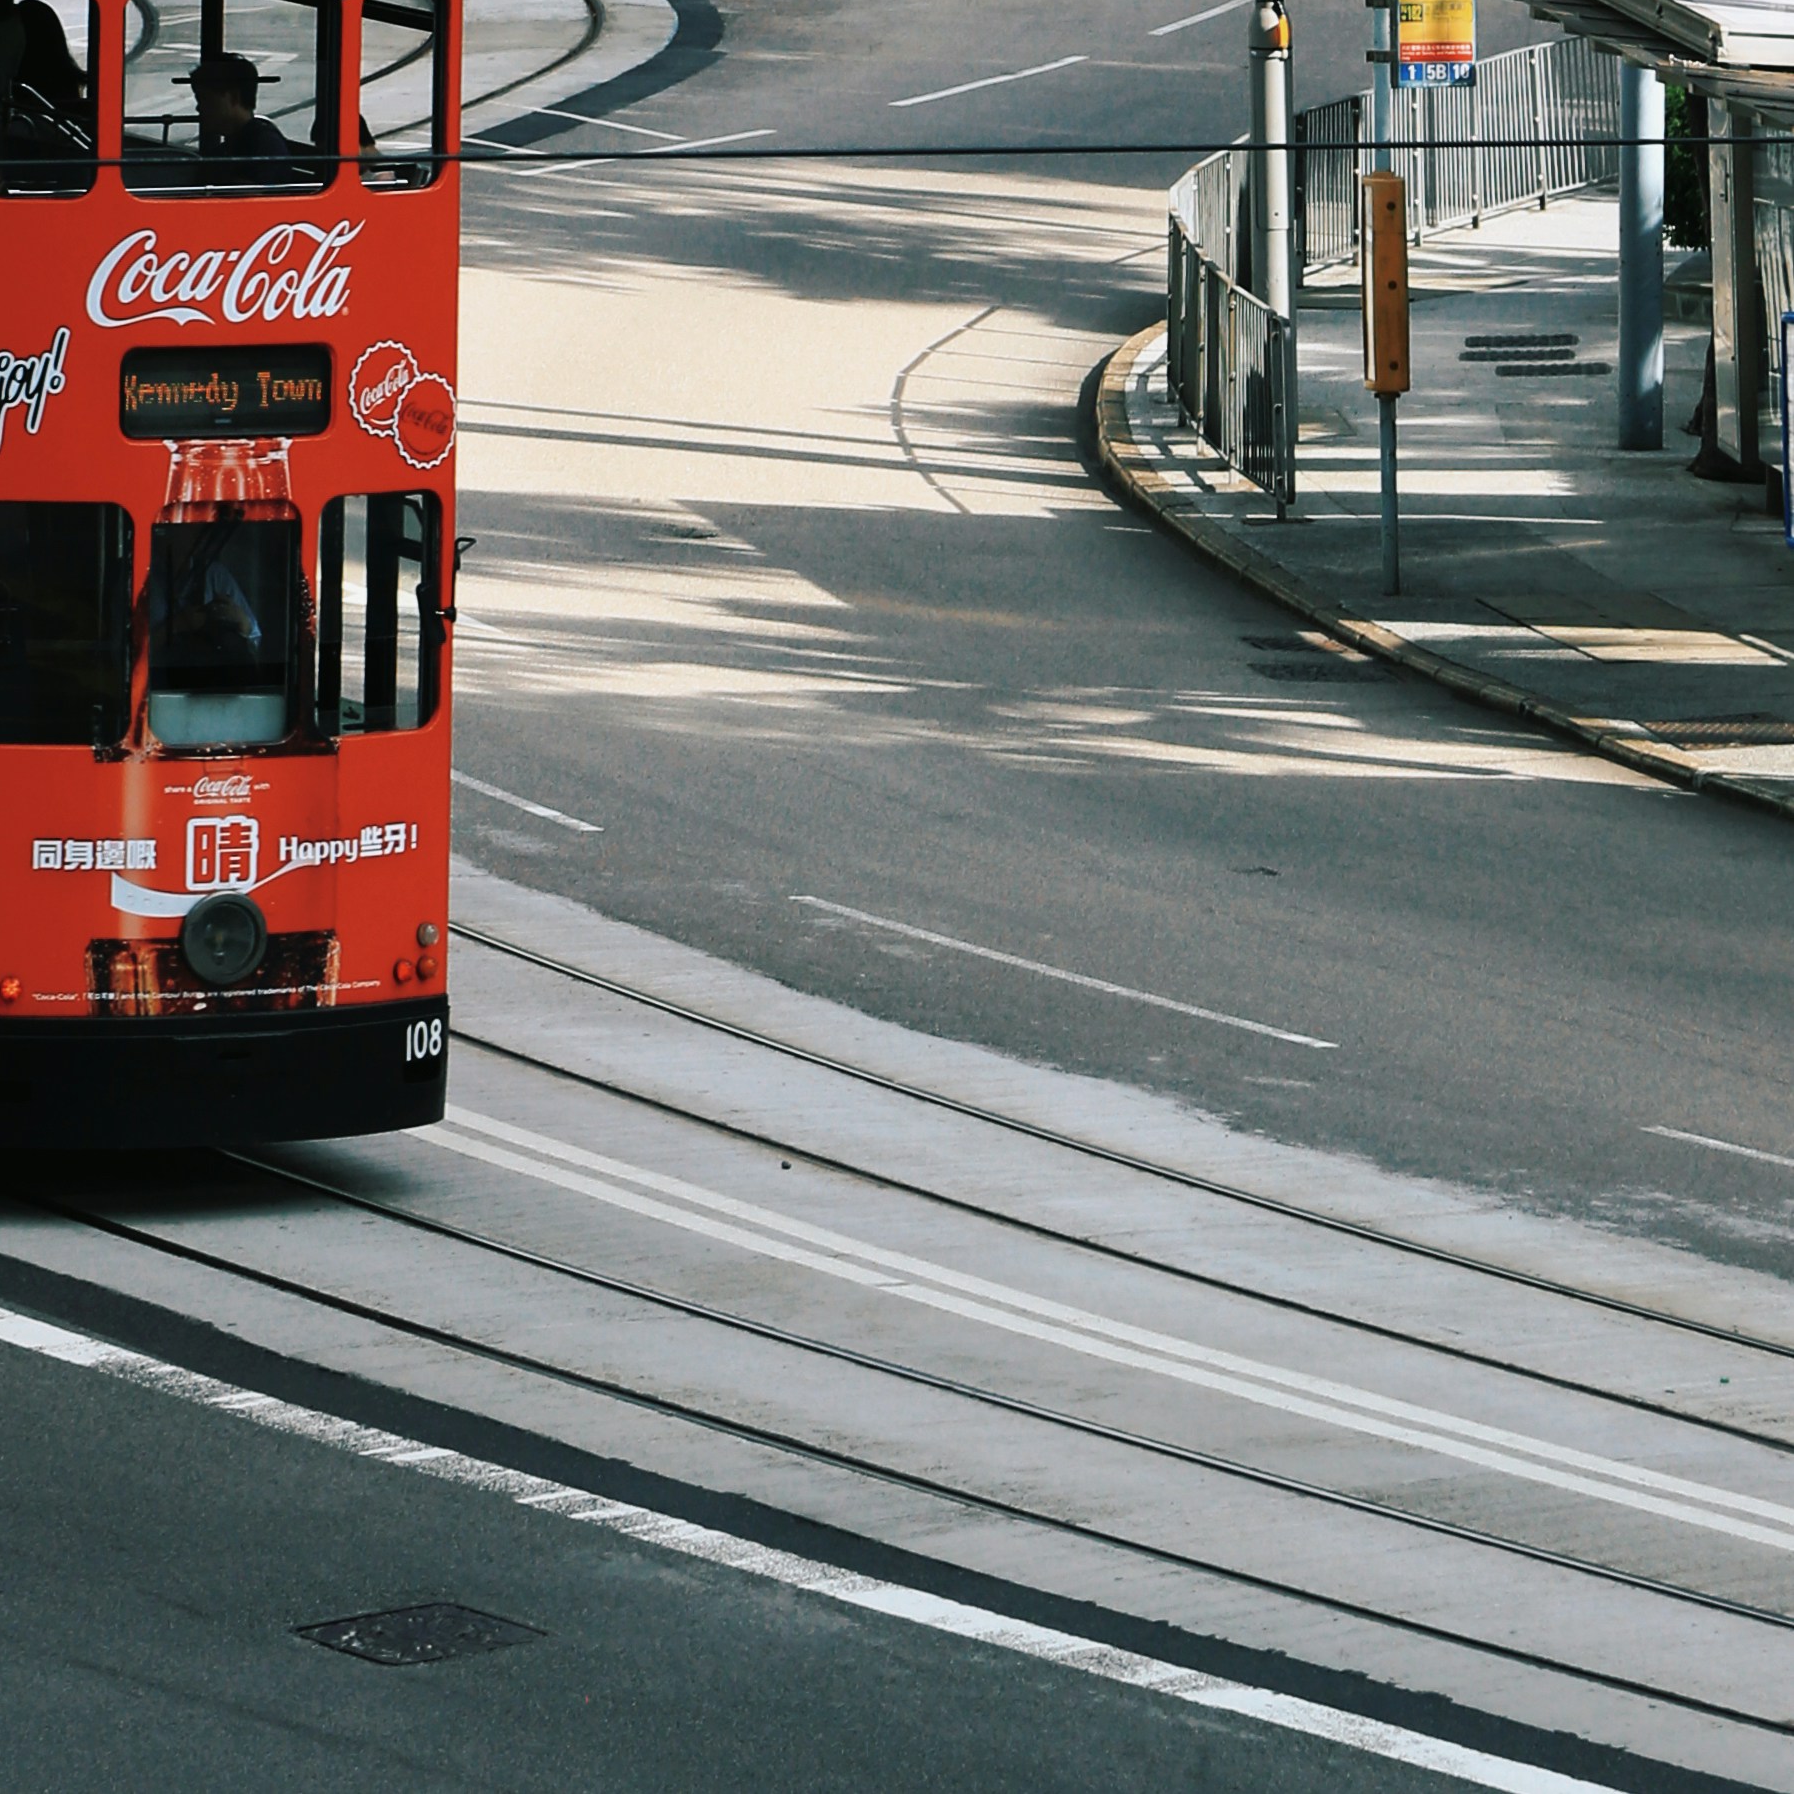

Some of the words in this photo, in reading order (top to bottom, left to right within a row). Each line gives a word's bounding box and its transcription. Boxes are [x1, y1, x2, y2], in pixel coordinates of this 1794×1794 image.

[1407, 64, 1417, 81] 1
[1426, 63, 1447, 81] 5B
[1452, 63, 1471, 79] 10
[85, 218, 366, 329] Coca-Cola
[123, 371, 239, 412] Kennedy
[256, 371, 323, 408] Town
[359, 358, 409, 415] Coca-Cola
[193, 774, 254, 798] Coca-Cola
[32, 837, 157, 870] 同身邊嘅
[186, 815, 259, 892] 晴
[405, 1017, 443, 1063] 108
